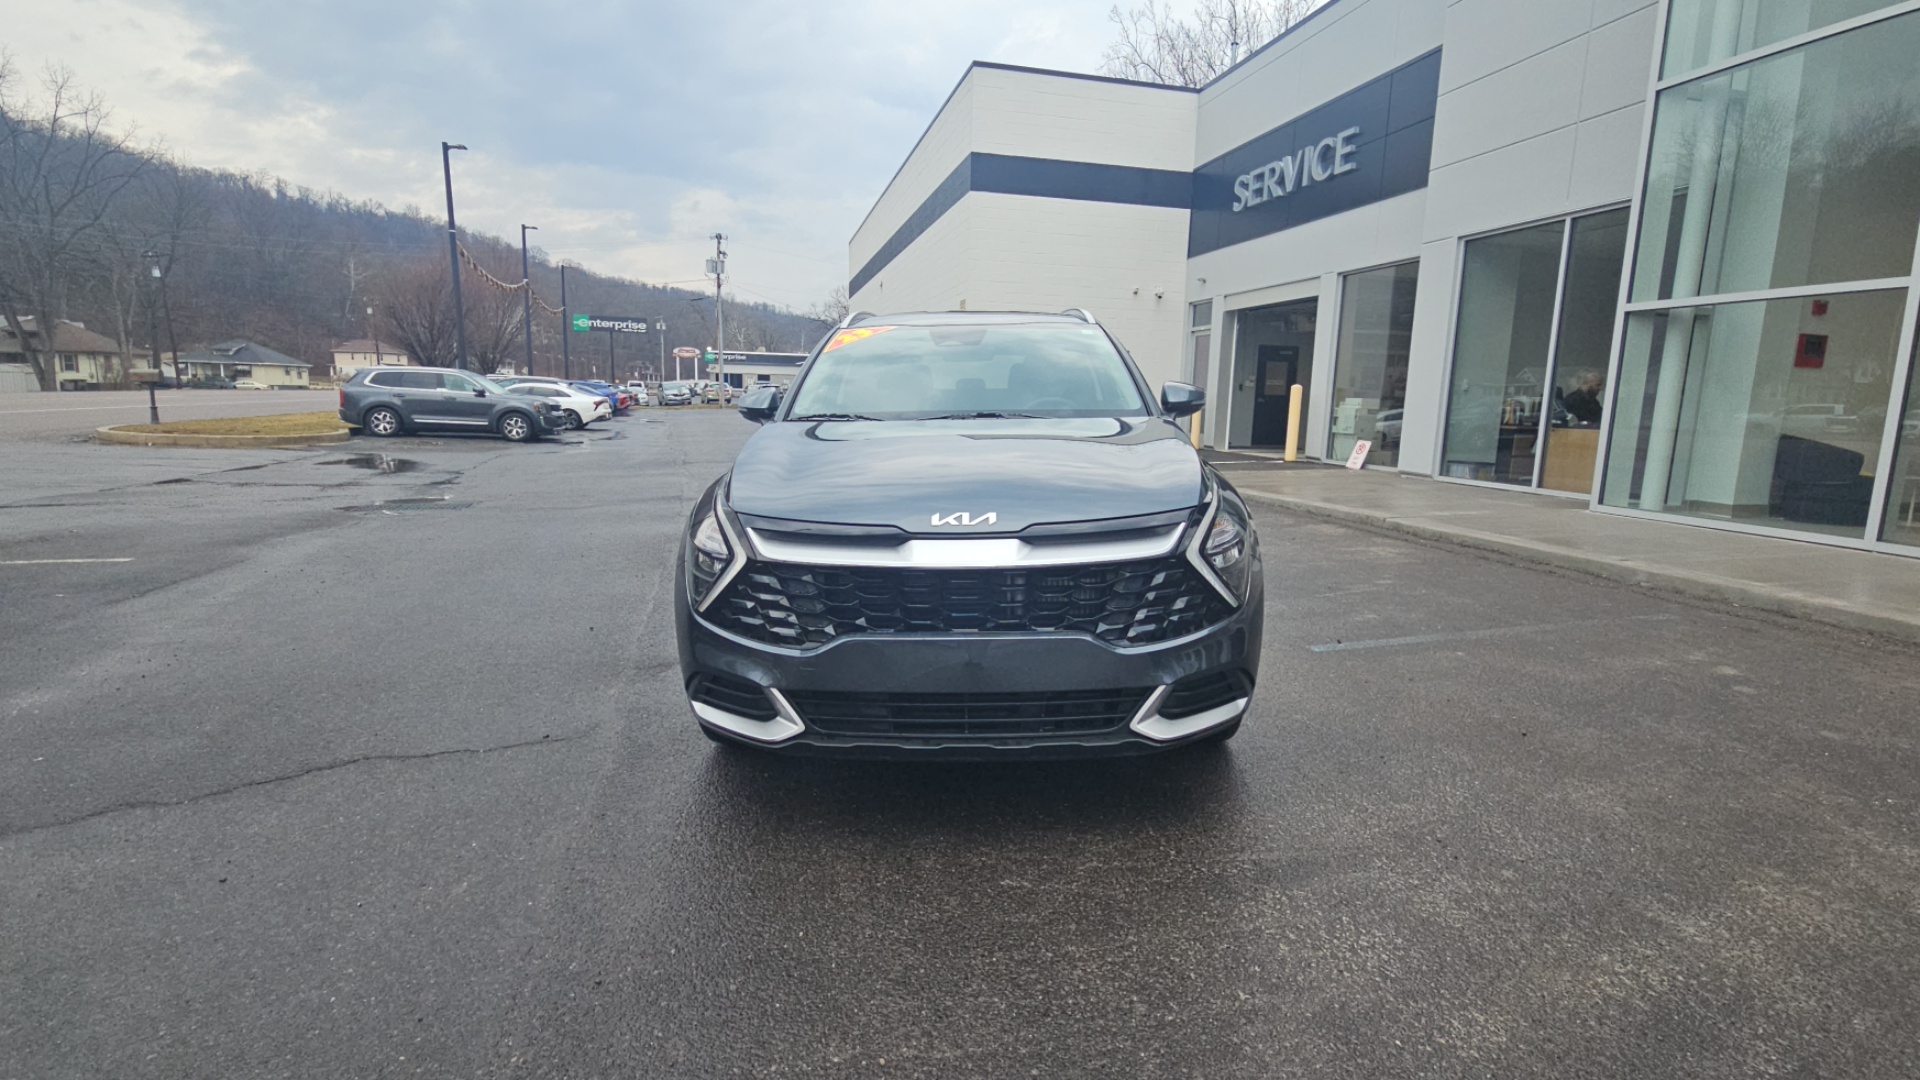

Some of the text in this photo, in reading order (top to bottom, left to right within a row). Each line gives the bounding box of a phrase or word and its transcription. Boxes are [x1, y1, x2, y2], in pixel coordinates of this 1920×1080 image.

[1232, 126, 1360, 212] SERVICE
[573, 318, 647, 331] enterprise
[931, 511, 997, 526] KIA
